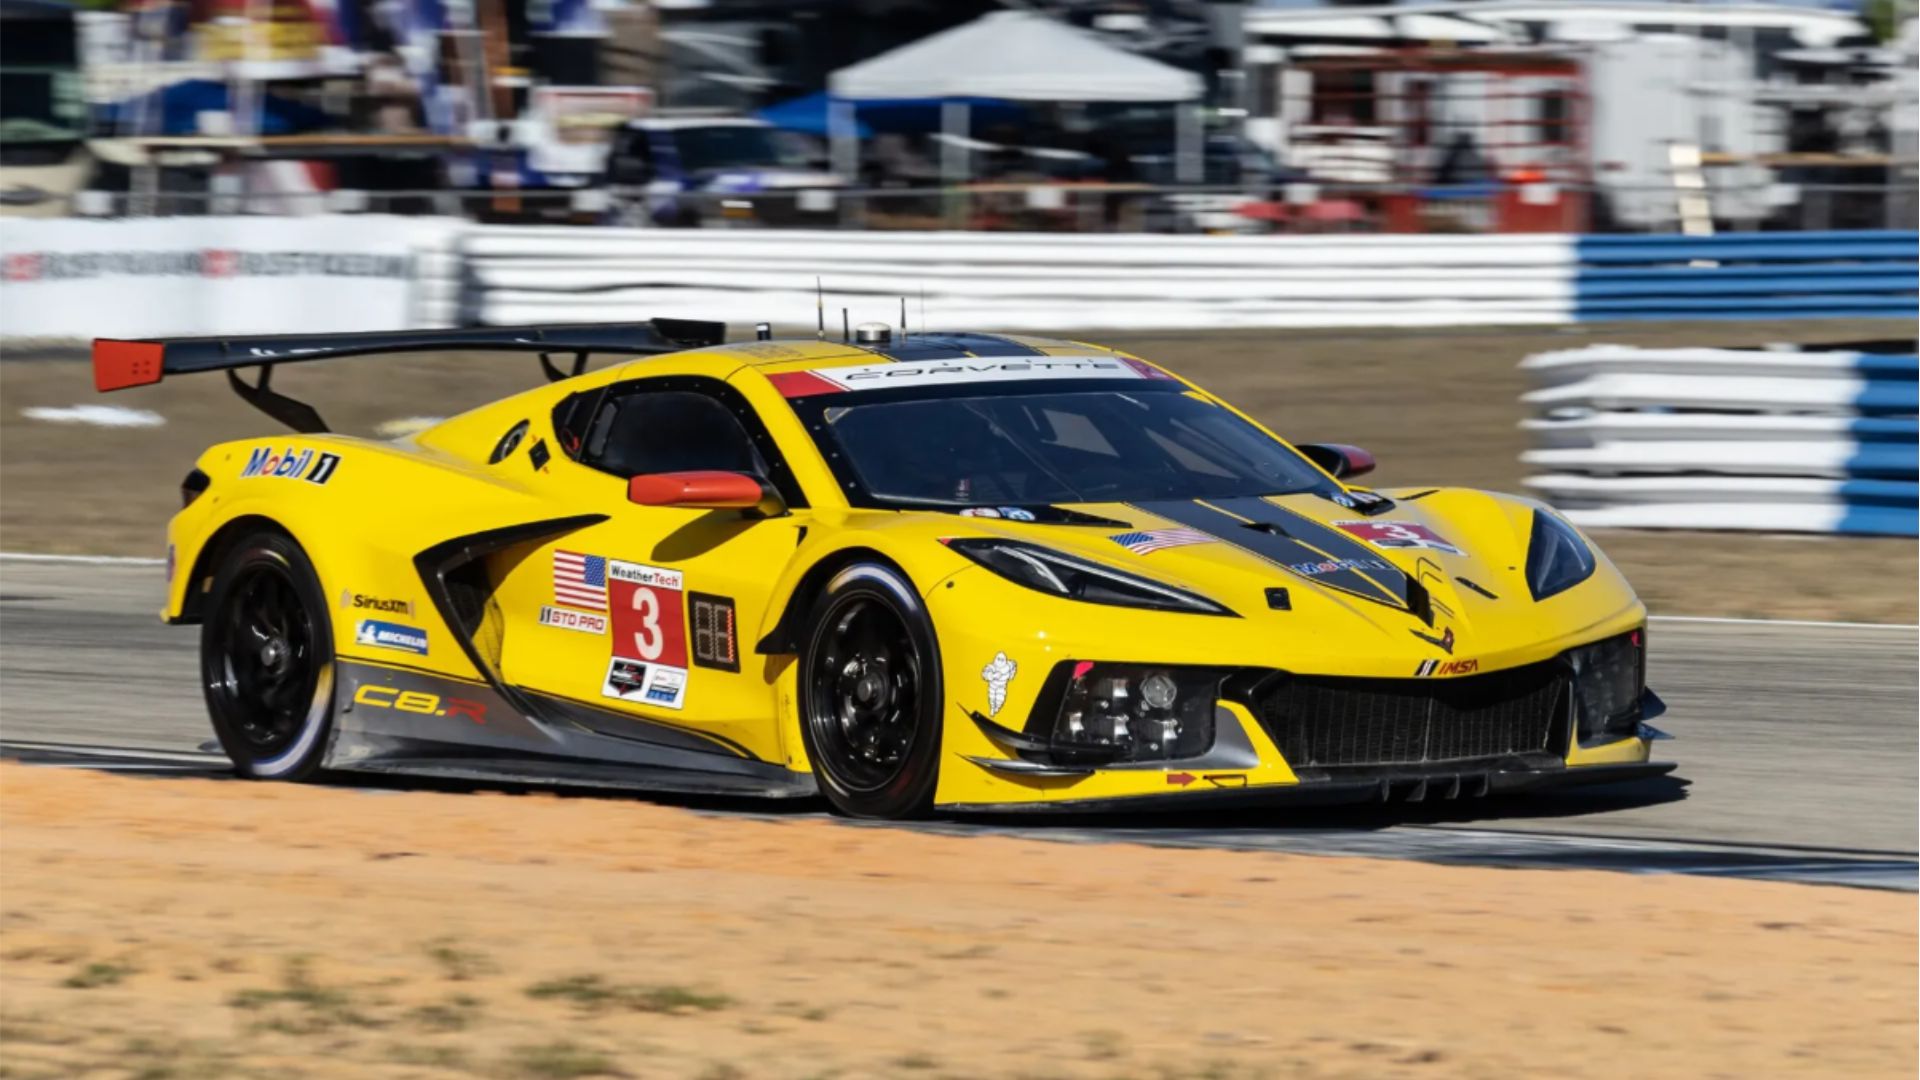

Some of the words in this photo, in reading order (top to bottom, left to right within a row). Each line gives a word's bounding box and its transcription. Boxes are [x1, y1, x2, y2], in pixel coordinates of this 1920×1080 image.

[845, 362, 1120, 381] CORVETTE
[241, 447, 314, 478] Mobil
[1371, 523, 1421, 540] 3
[611, 565, 679, 587] WeatherTech
[551, 611, 577, 626] GTD
[579, 615, 605, 631] PRO
[632, 587, 664, 660] 3
[377, 630, 428, 650] MICHELIN
[1439, 659, 1479, 675] IMSA
[354, 684, 487, 724] C8.R
